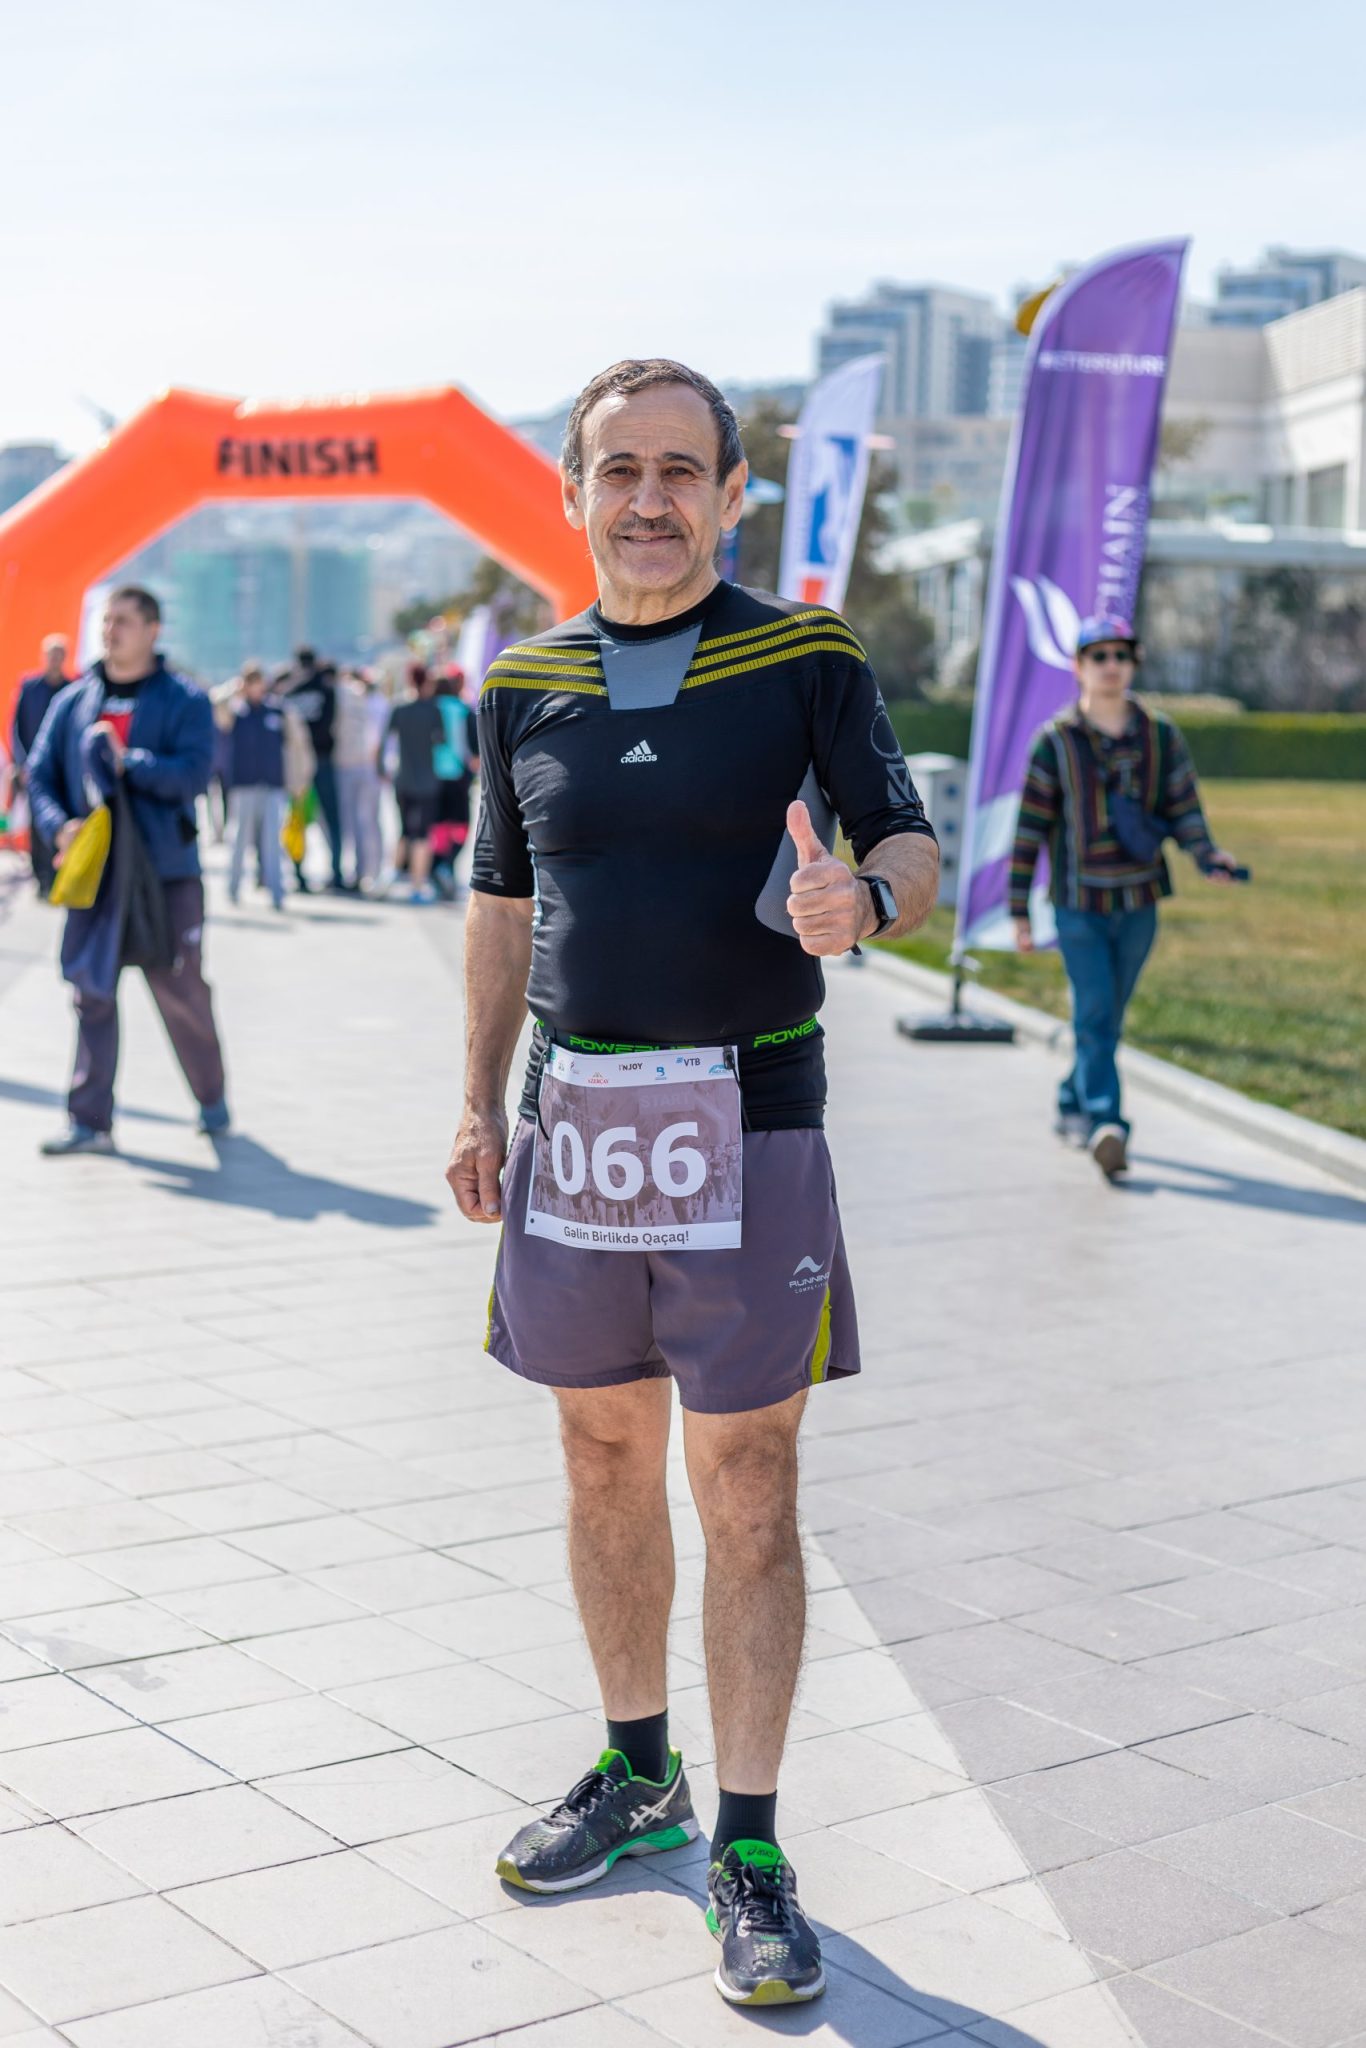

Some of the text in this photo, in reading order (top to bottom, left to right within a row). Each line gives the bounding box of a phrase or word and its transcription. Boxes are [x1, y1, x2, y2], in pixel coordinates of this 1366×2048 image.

[217, 437, 379, 476] FINISH
[620, 754, 658, 764] adidas
[683, 1058, 701, 1067] VTB
[551, 1120, 707, 1200] 066
[563, 1226, 690, 1246] Gəlin Birlikdə Qaçaq!
